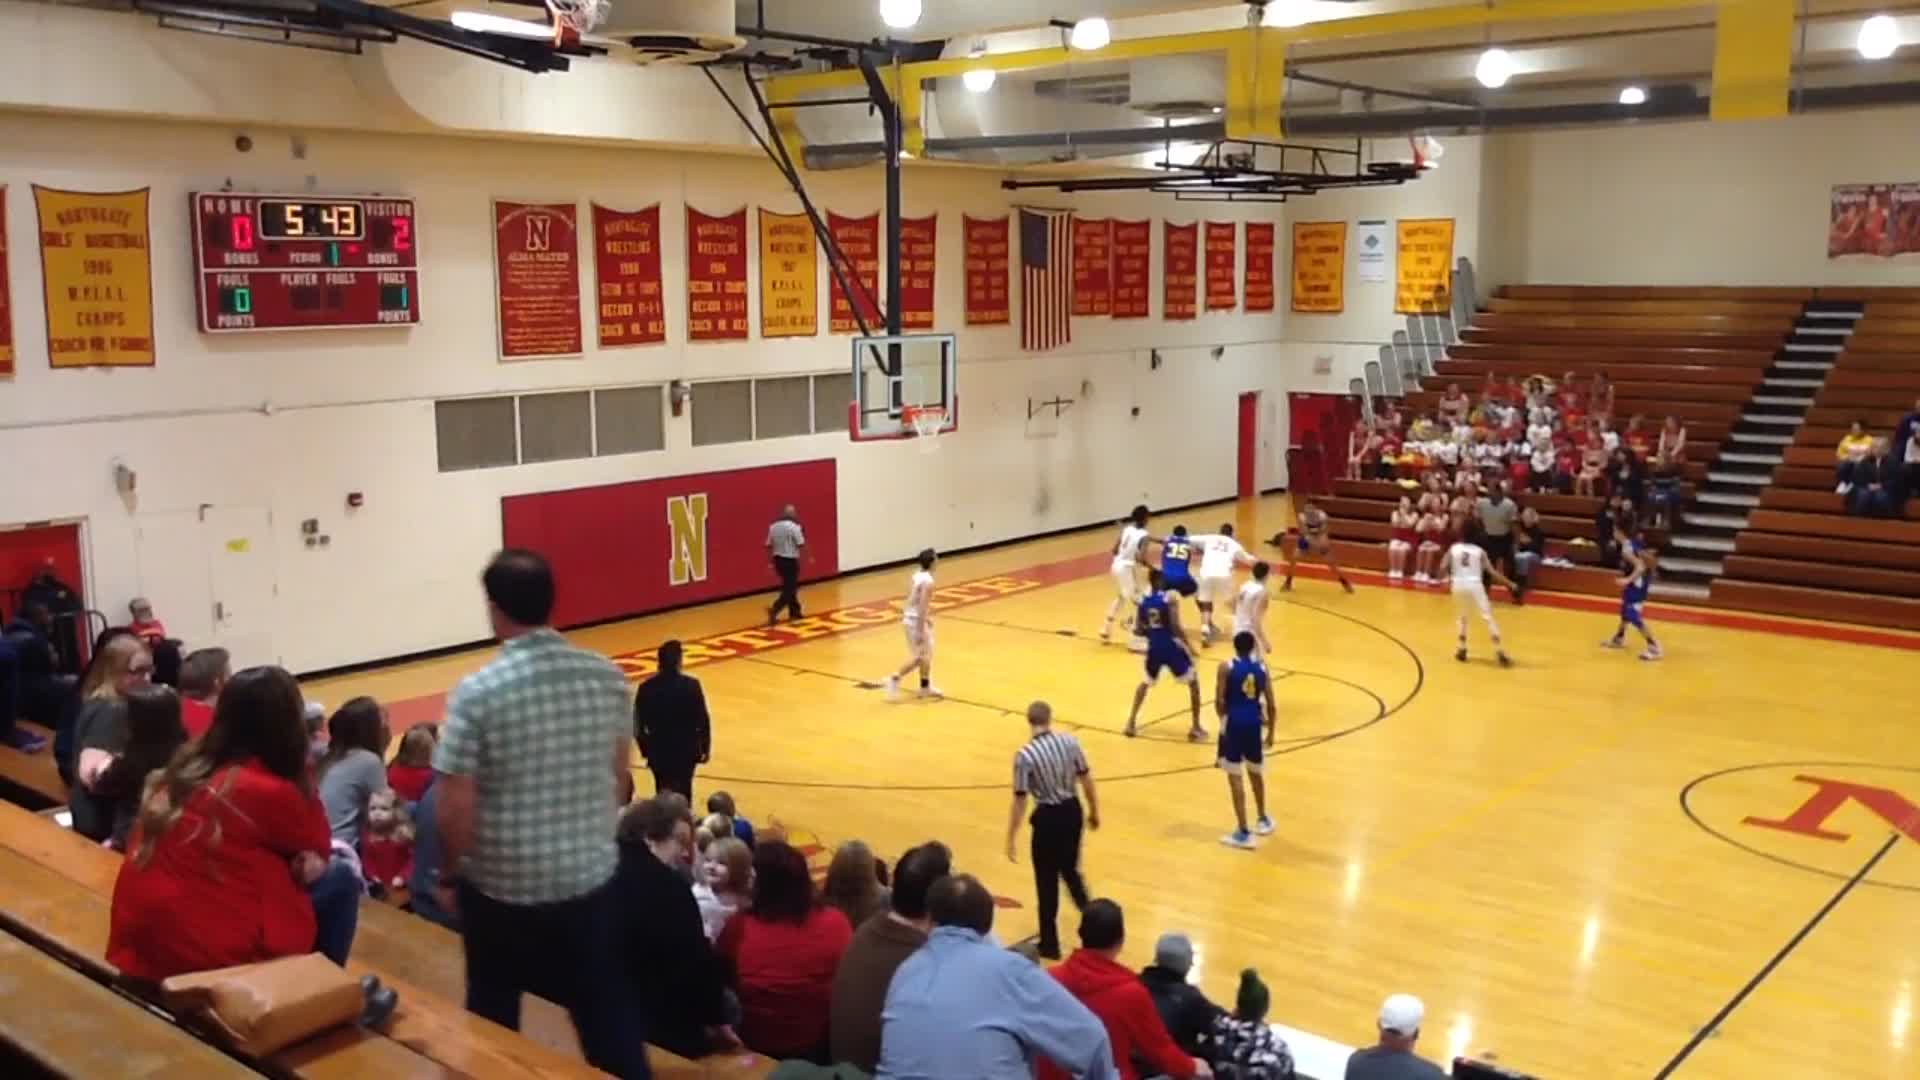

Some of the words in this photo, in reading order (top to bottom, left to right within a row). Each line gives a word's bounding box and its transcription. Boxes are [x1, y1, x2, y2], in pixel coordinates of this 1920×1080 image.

[205, 198, 253, 214] HOME
[366, 202, 412, 217] VISITOR
[232, 215, 254, 251] 0
[391, 217, 410, 250] 2
[526, 215, 550, 250] N
[224, 252, 259, 265] BONUS
[290, 252, 321, 264] PERIOD
[367, 252, 398, 265] BONUS
[217, 273, 249, 286] FOULS
[280, 273, 318, 285] PLAYER
[326, 272, 356, 285] FOULS
[377, 272, 406, 284] FOULS
[234, 288, 250, 313] 0
[401, 287, 408, 308] 1
[217, 315, 255, 328] POINTS
[377, 310, 410, 323] POINTS
[667, 493, 708, 586] N
[1165, 542, 1191, 560] 35
[1242, 672, 1257, 699] 4
